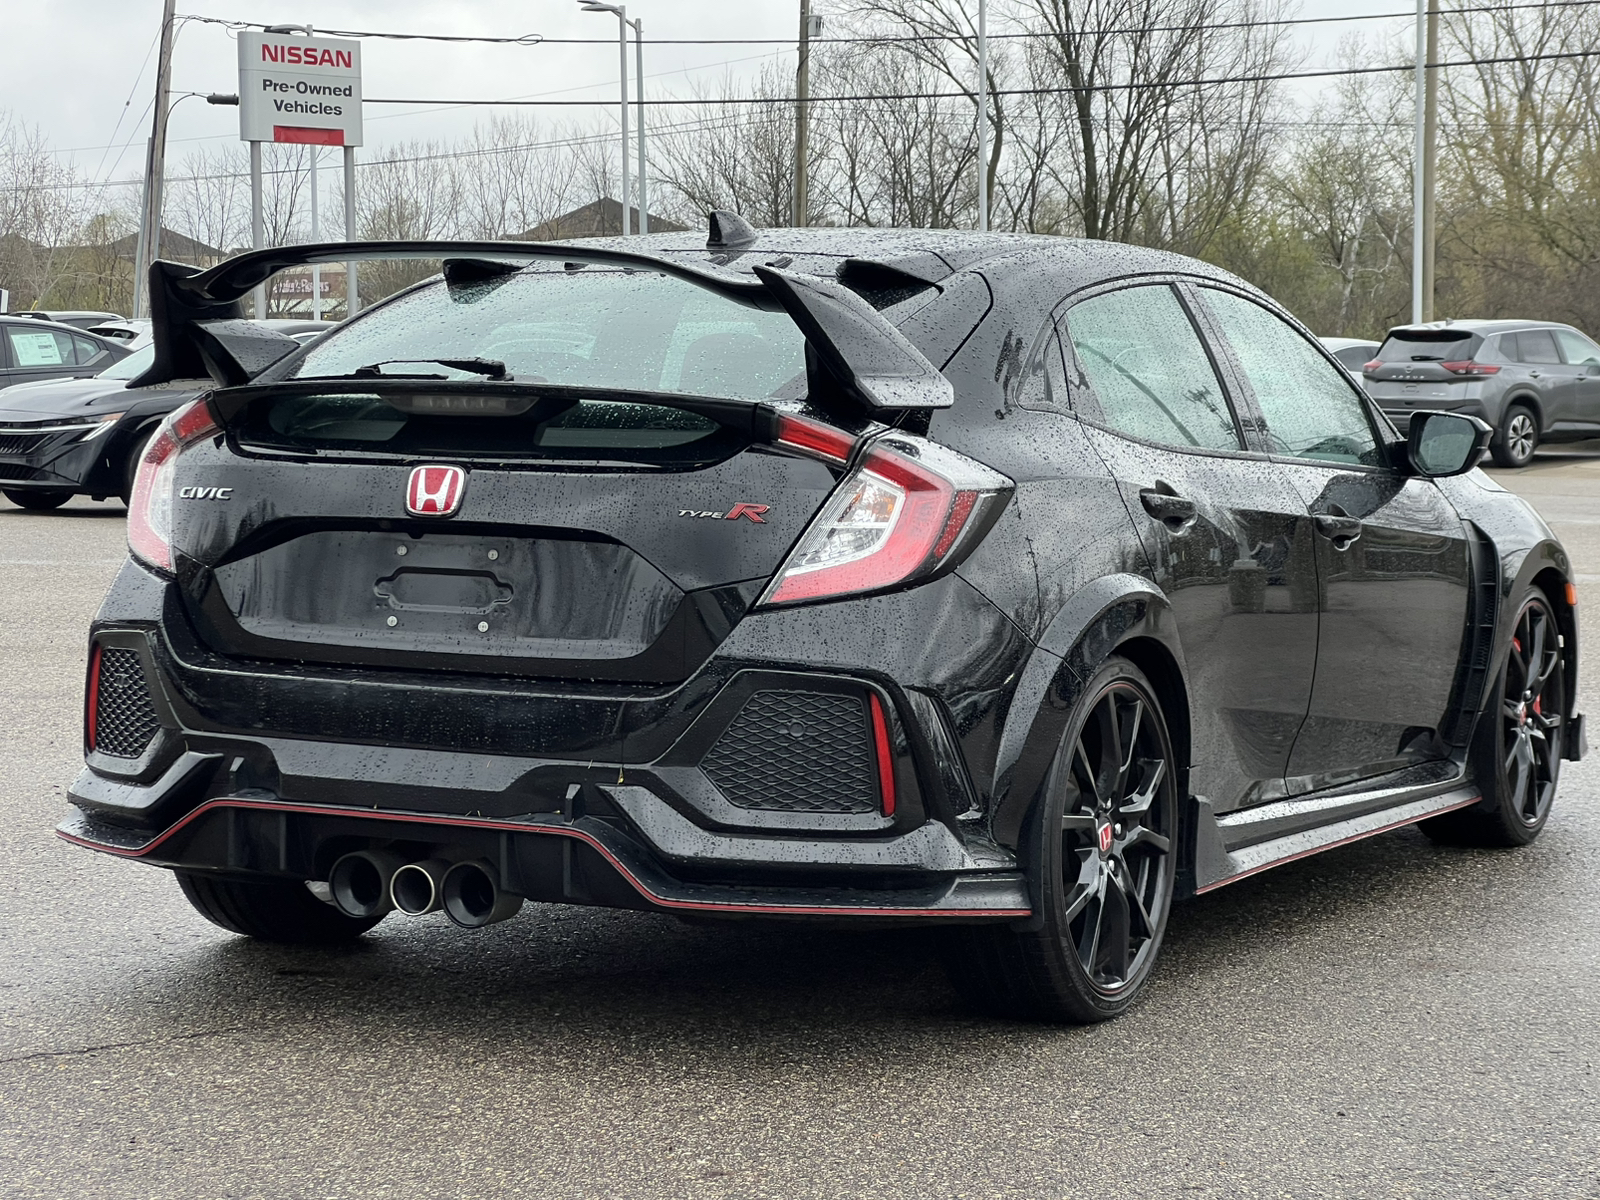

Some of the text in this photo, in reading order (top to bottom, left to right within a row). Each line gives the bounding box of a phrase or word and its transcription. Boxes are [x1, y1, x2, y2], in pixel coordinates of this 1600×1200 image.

[261, 43, 353, 68] NISSAN
[262, 78, 353, 97] Pre-Owned
[273, 99, 343, 116] Vehicles
[179, 486, 234, 500] CIVIC
[678, 502, 771, 524] TYPE R
